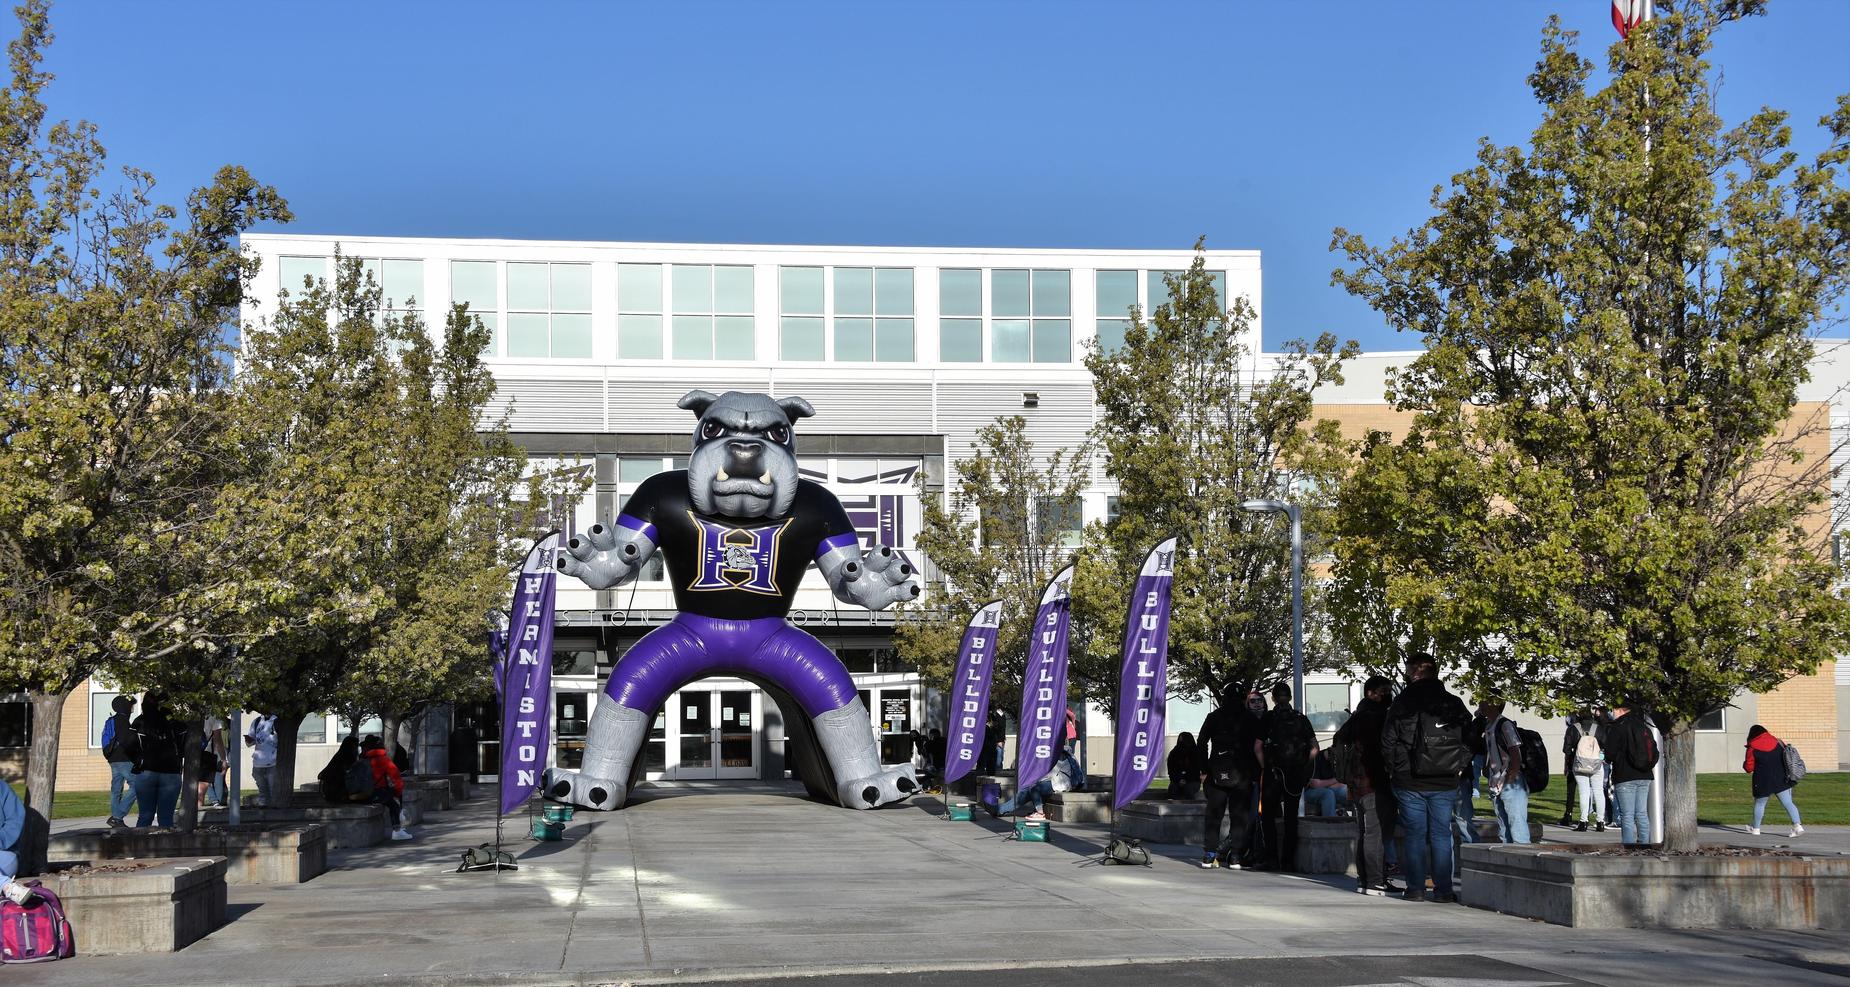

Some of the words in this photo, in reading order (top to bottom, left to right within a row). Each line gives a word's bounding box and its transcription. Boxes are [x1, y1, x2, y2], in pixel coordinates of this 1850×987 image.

[517, 577, 542, 787] HERMISTON
[960, 637, 986, 760] BULLDOGS
[1035, 612, 1058, 759] BULLDOGS
[1133, 592, 1158, 771] BULLDOGS
